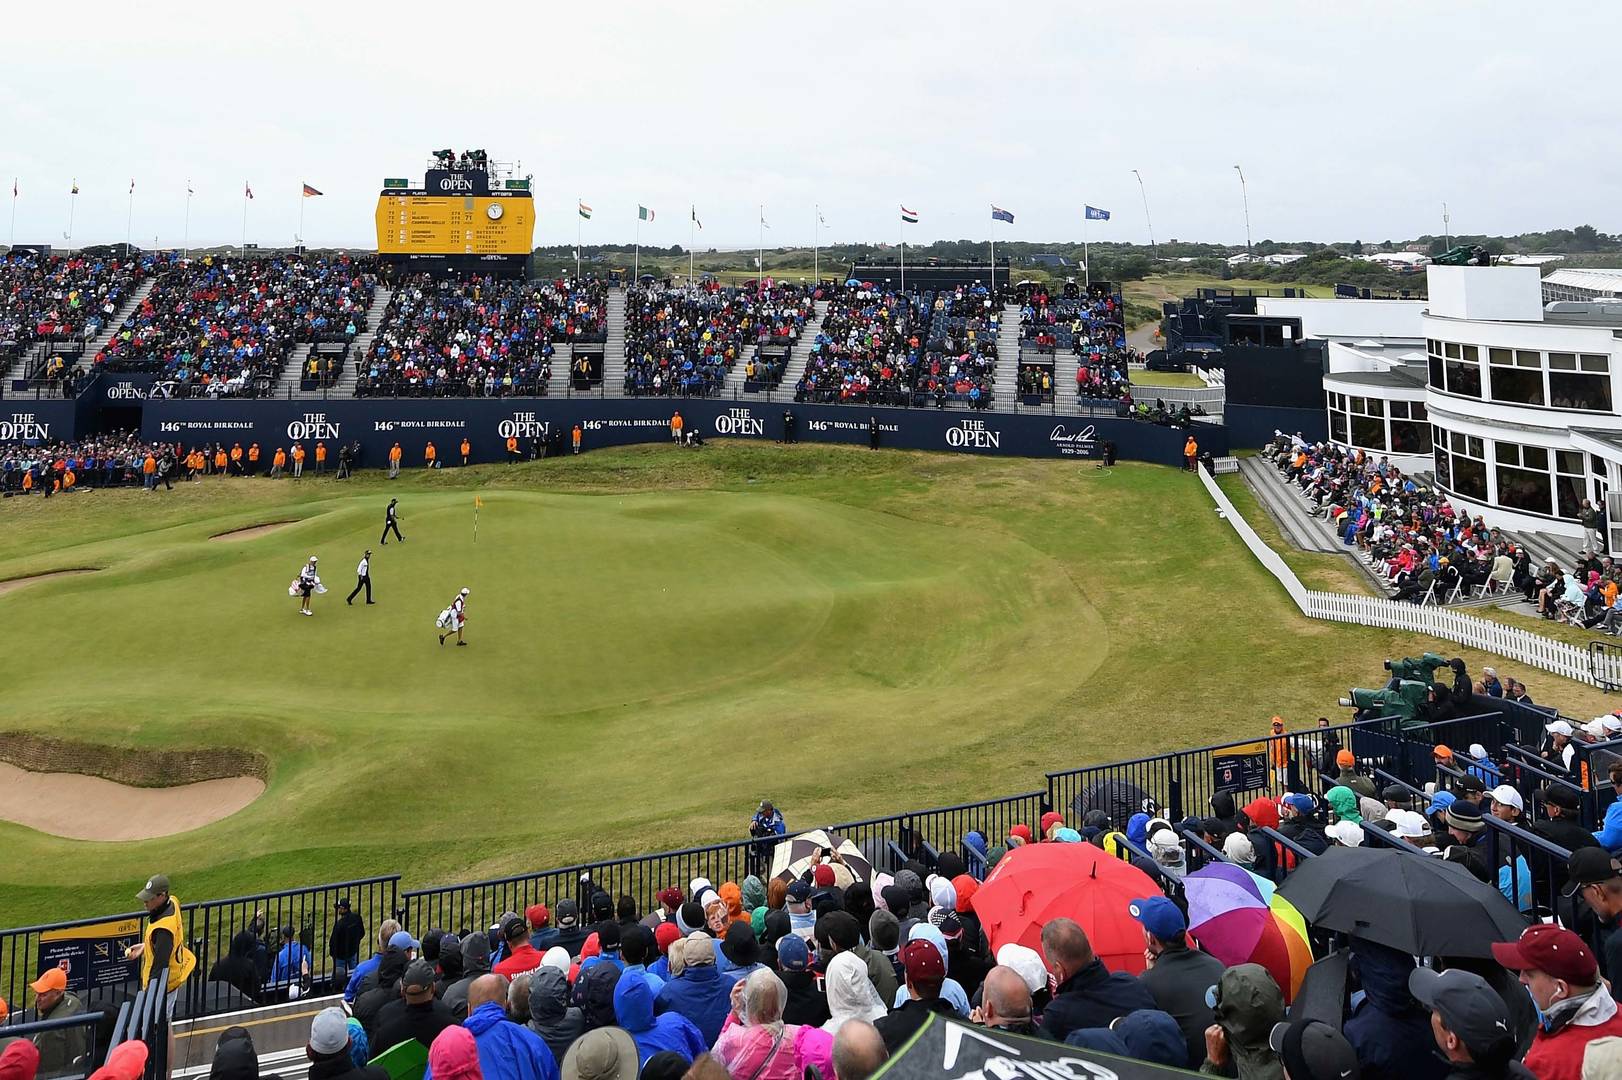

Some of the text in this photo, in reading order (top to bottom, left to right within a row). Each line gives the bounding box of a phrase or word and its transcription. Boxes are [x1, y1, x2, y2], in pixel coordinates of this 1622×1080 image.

[440, 179, 473, 190] OPEN
[108, 388, 140, 400] OPEN
[12, 414, 34, 423] THE
[303, 414, 326, 423] THE
[514, 412, 535, 422] THE
[729, 408, 750, 418] THE
[0, 422, 49, 439] OPEN
[287, 421, 340, 440] OPEN
[498, 420, 549, 438] OPEN
[715, 415, 764, 435] OPEN
[860, 423, 899, 432] BIDALE
[961, 420, 984, 430] THE
[946, 427, 1000, 448] OPEN
